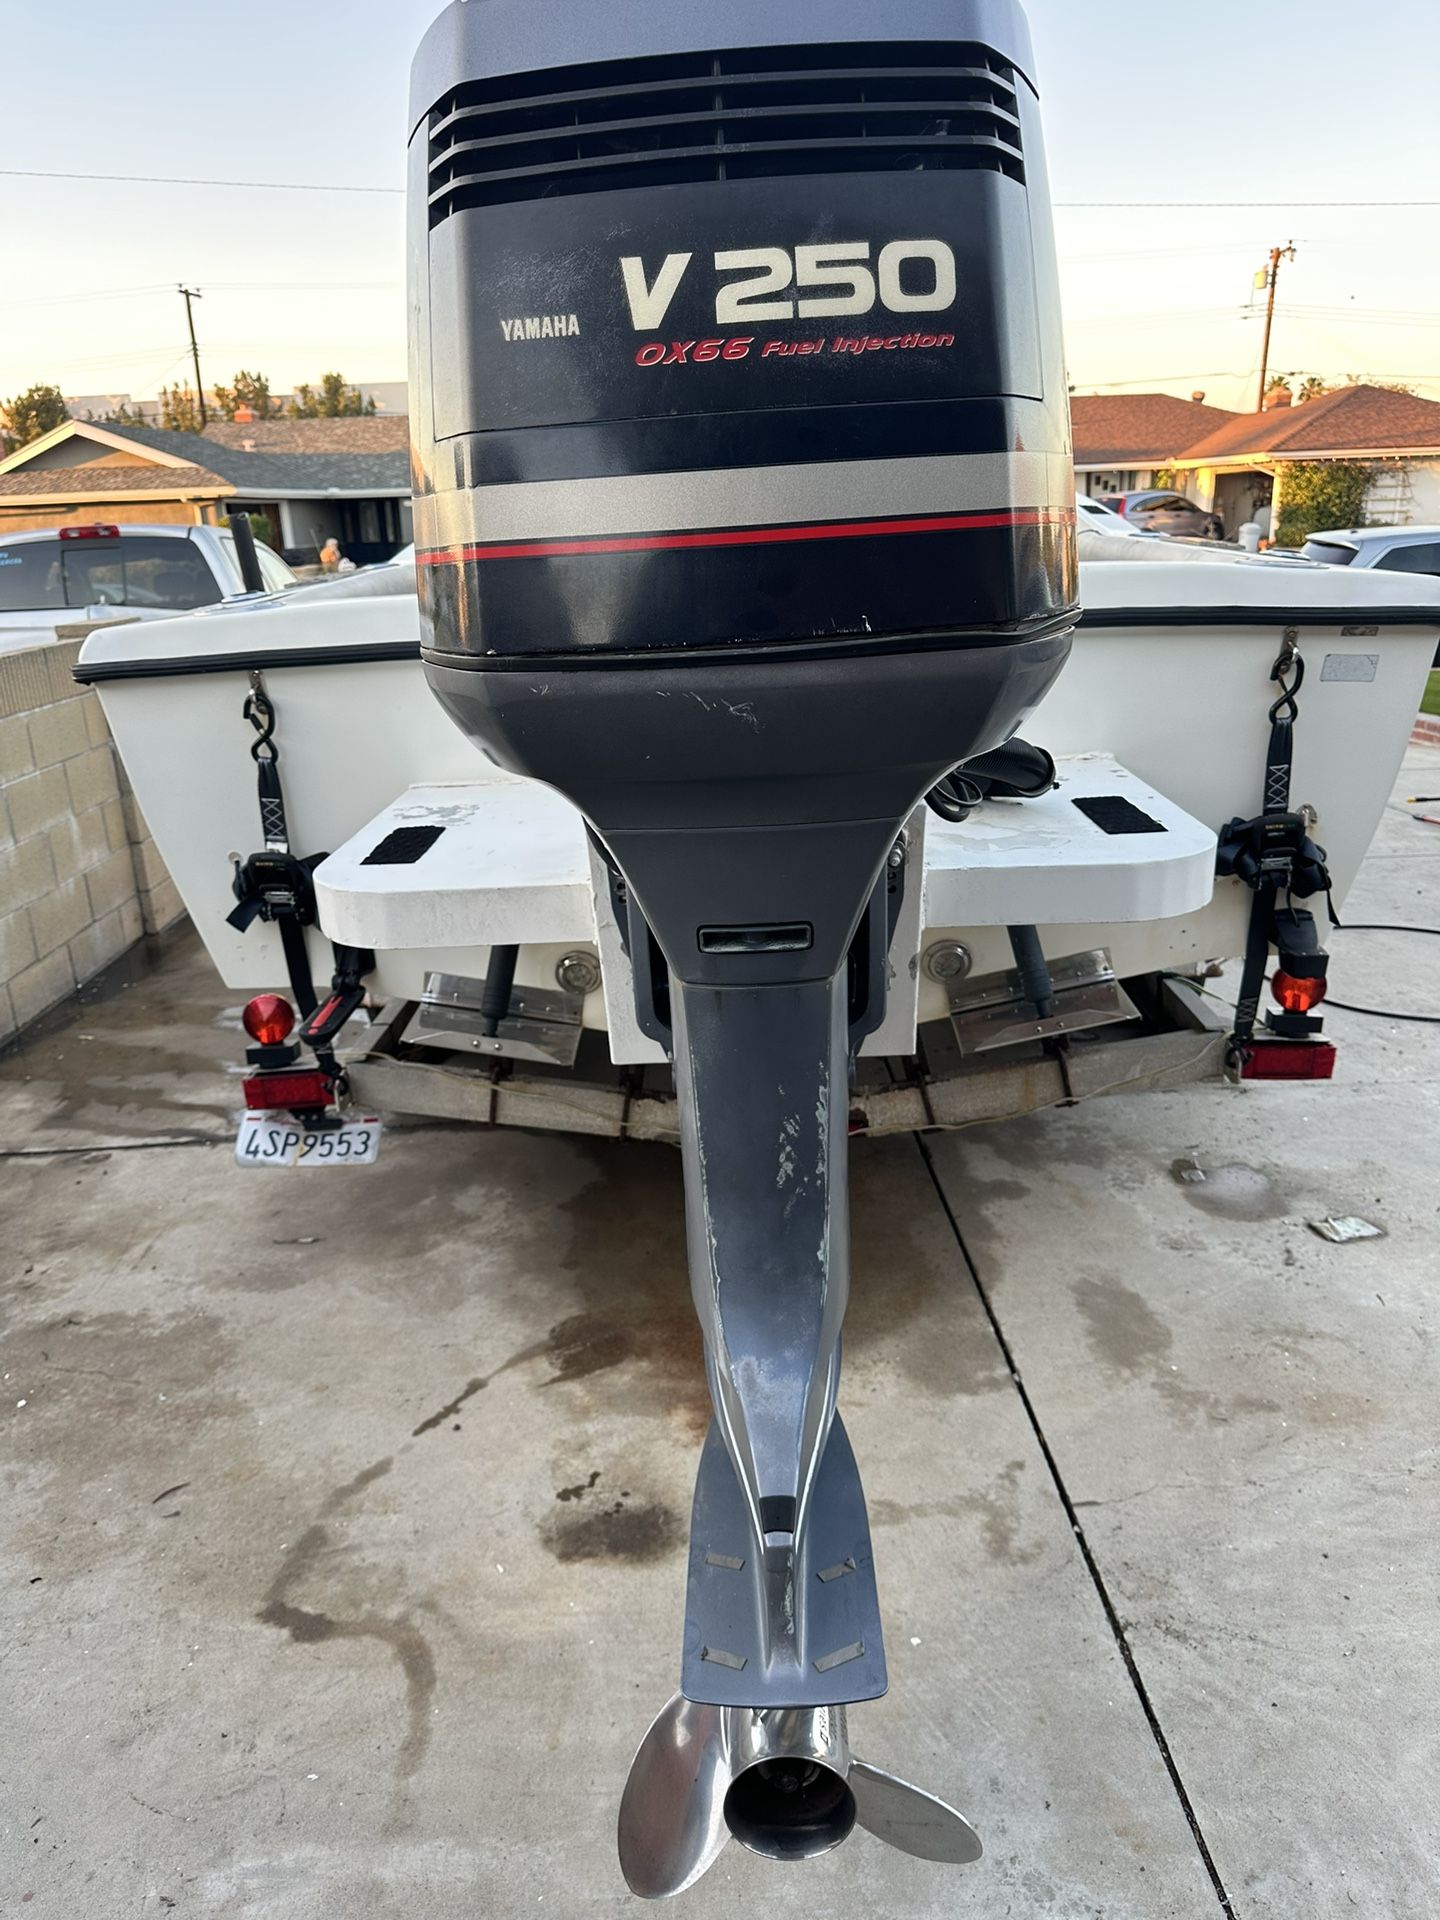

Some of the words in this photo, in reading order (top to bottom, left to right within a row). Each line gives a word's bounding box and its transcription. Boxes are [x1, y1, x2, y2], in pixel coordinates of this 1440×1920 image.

[620, 252, 692, 331] V
[714, 239, 957, 324] 250
[501, 314, 580, 342] YAMAHA
[634, 336, 755, 367] OX66
[761, 338, 825, 357] Fuel
[832, 332, 955, 354] Injection
[245, 1129, 371, 1158] 4SP9553
